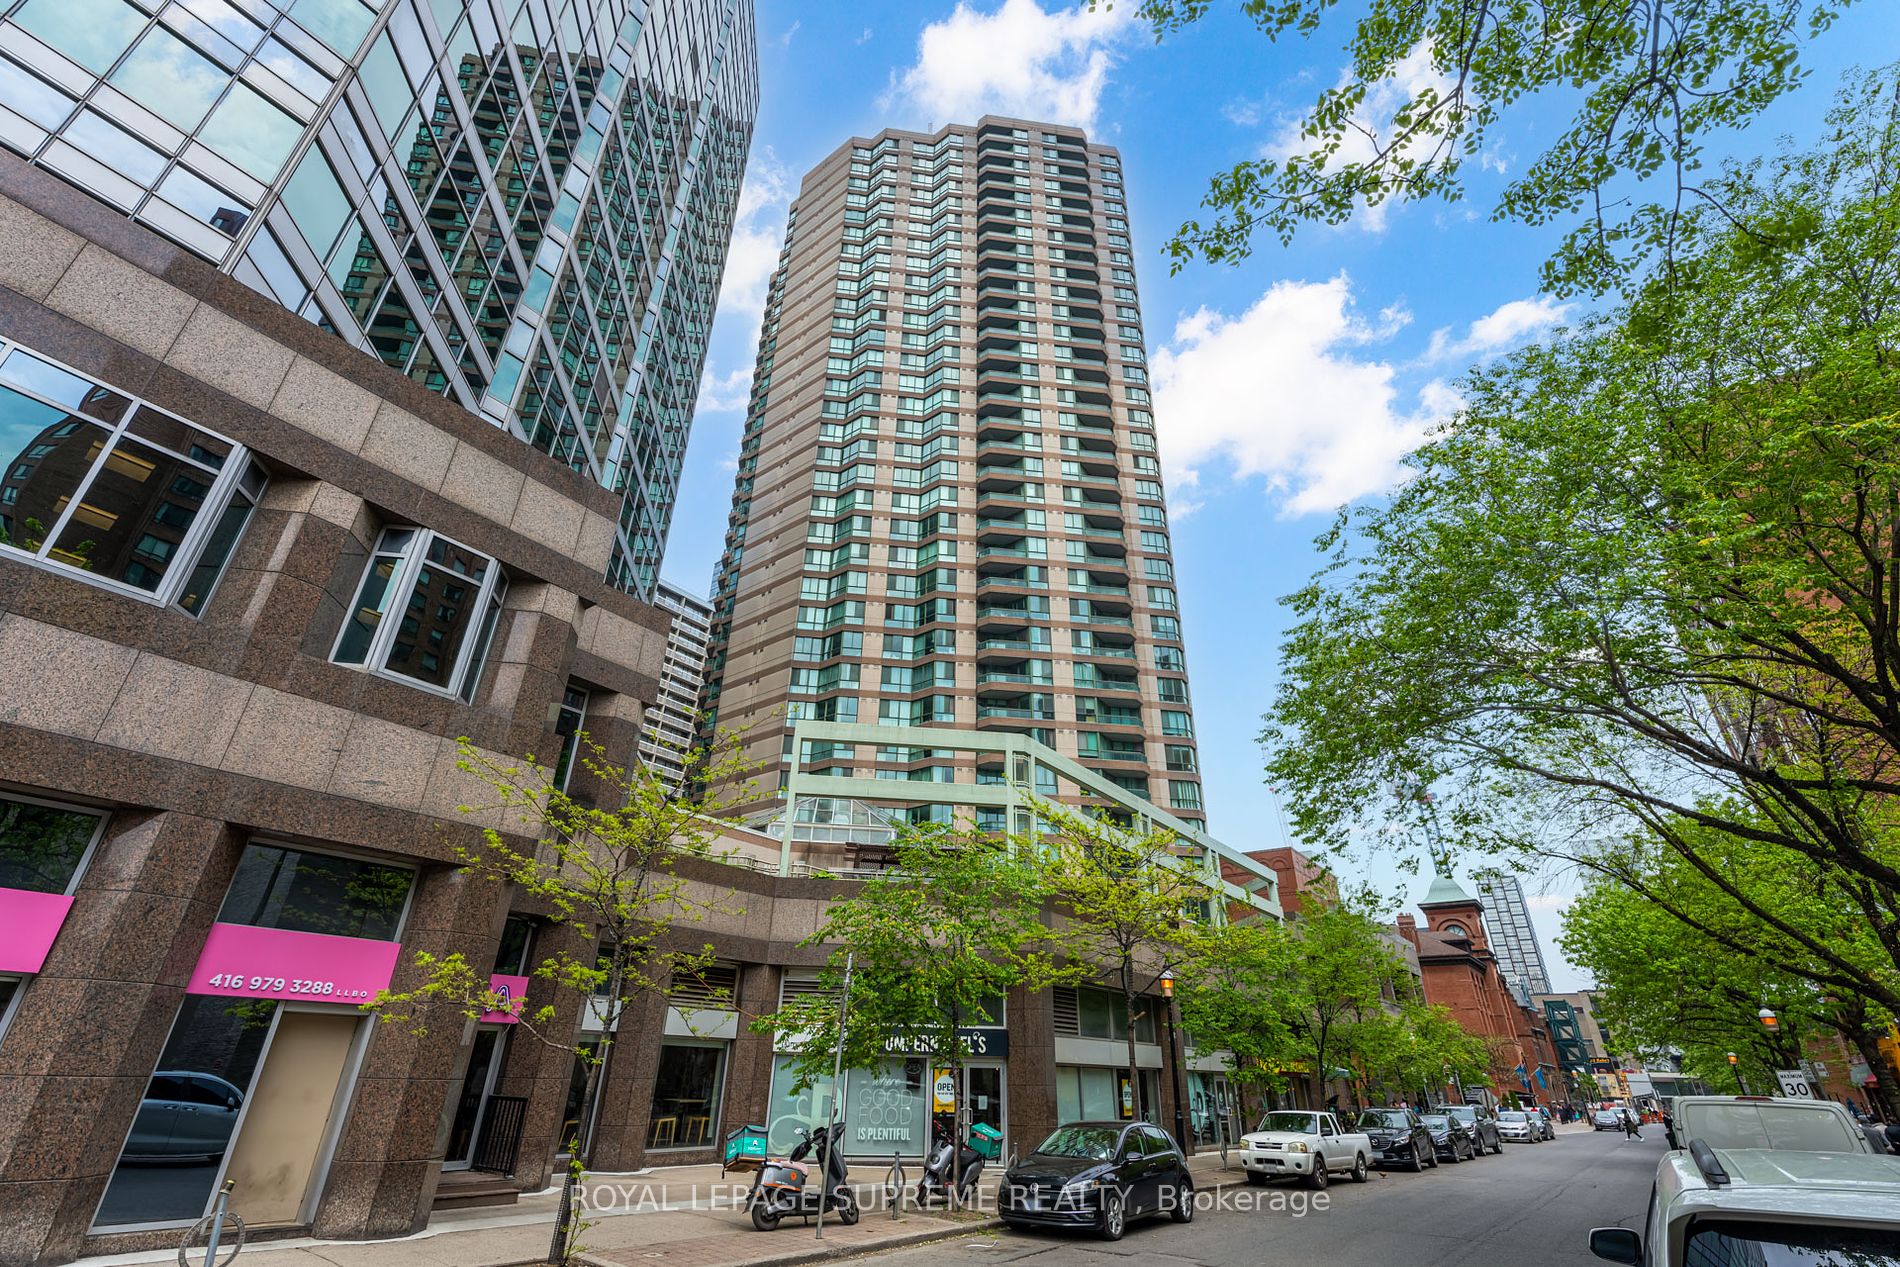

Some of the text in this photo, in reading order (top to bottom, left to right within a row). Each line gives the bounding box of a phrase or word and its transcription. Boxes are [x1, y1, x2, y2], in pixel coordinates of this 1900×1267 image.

[209, 973, 368, 998] 416 979 3288 LLBO
[860, 1088, 913, 1106] GOOD
[1785, 1083, 1809, 1096] 30
[859, 1106, 912, 1125] FOOD
[857, 1127, 911, 1141] IS PLENTIFUL
